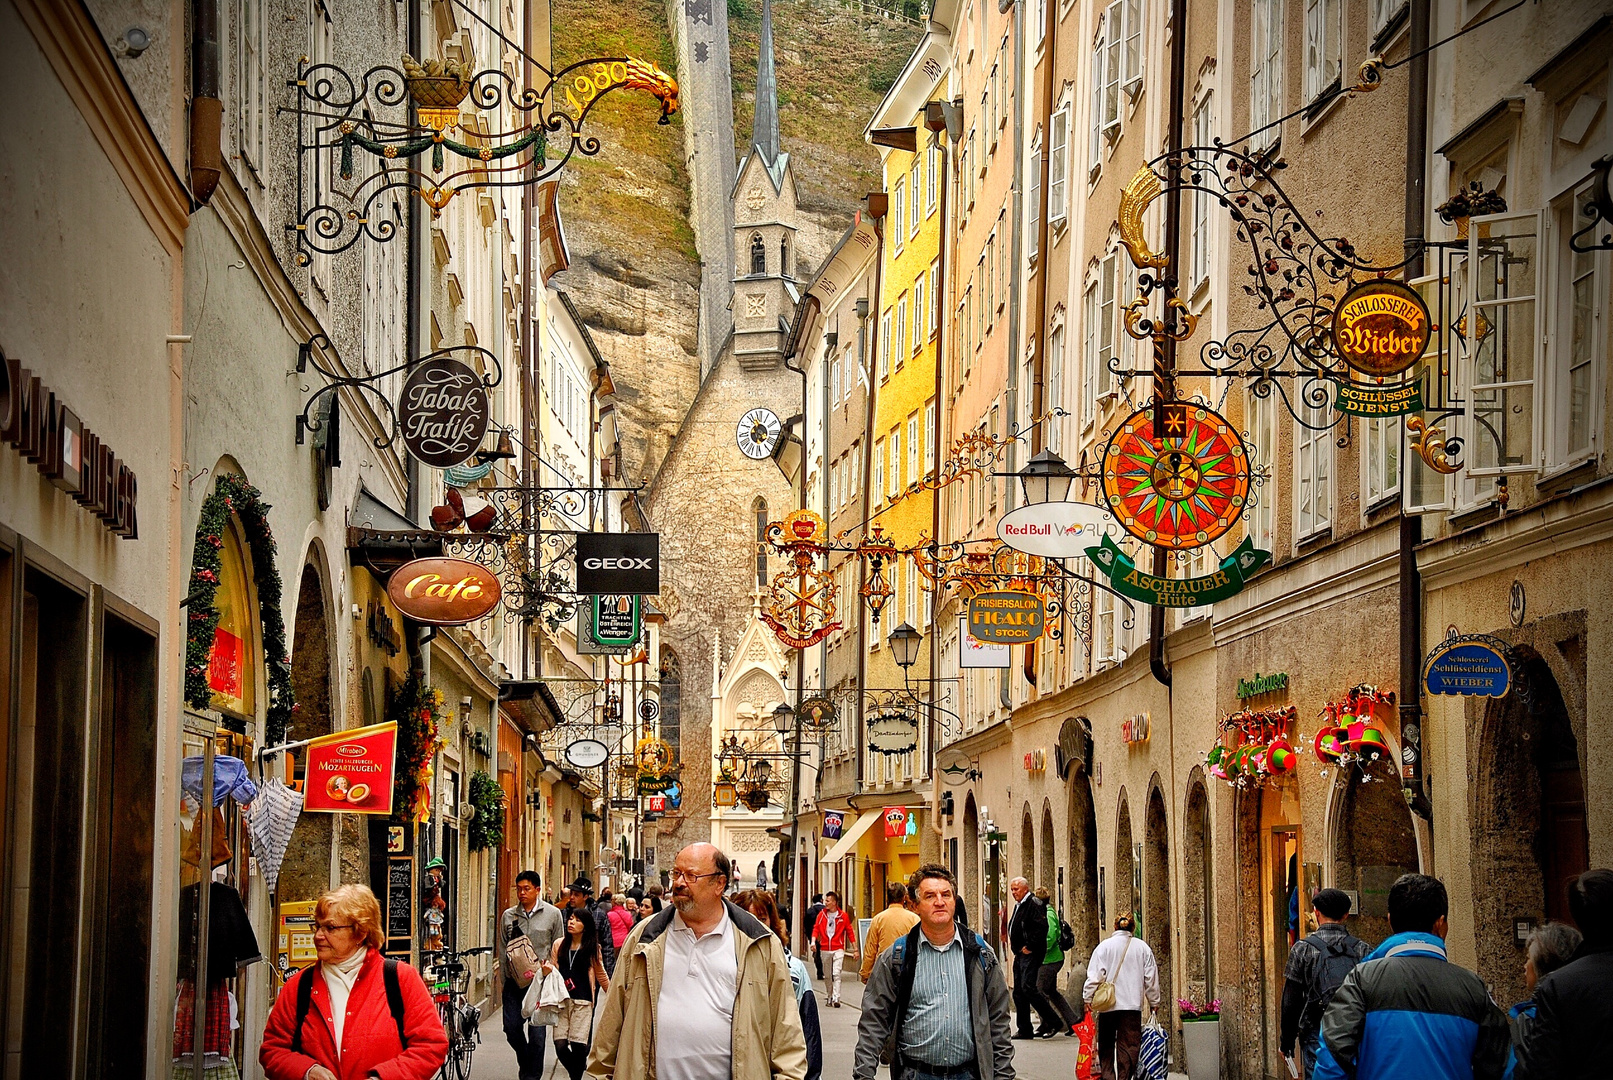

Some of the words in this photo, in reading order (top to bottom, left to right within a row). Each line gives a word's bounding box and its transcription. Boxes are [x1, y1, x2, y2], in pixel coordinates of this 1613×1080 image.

[566, 62, 627, 120] 1980
[1344, 297, 1420, 322] SCHLOSSEREI
[1340, 325, 1422, 354] Wieber
[407, 378, 483, 413] Tabak
[1340, 386, 1419, 402] SCHLÜSSEL
[1346, 400, 1410, 413] DIENST
[405, 411, 481, 442] Trafik
[1005, 524, 1027, 535] Red
[1029, 524, 1051, 535] Bull
[583, 557, 652, 570] GEOX
[404, 573, 484, 603] Café
[1123, 570, 1230, 594] ASCHAUER
[975, 599, 1038, 609] FRISIERSALON
[1156, 593, 1196, 606] Hüte
[972, 611, 1041, 626] FIGARO
[995, 629, 1029, 637] STOCK
[1447, 655, 1489, 664] Schlosserei
[1434, 664, 1504, 674] Schlüsseldienst
[1441, 678, 1494, 687] WIEBER
[641, 781, 668, 790] STASSNY
